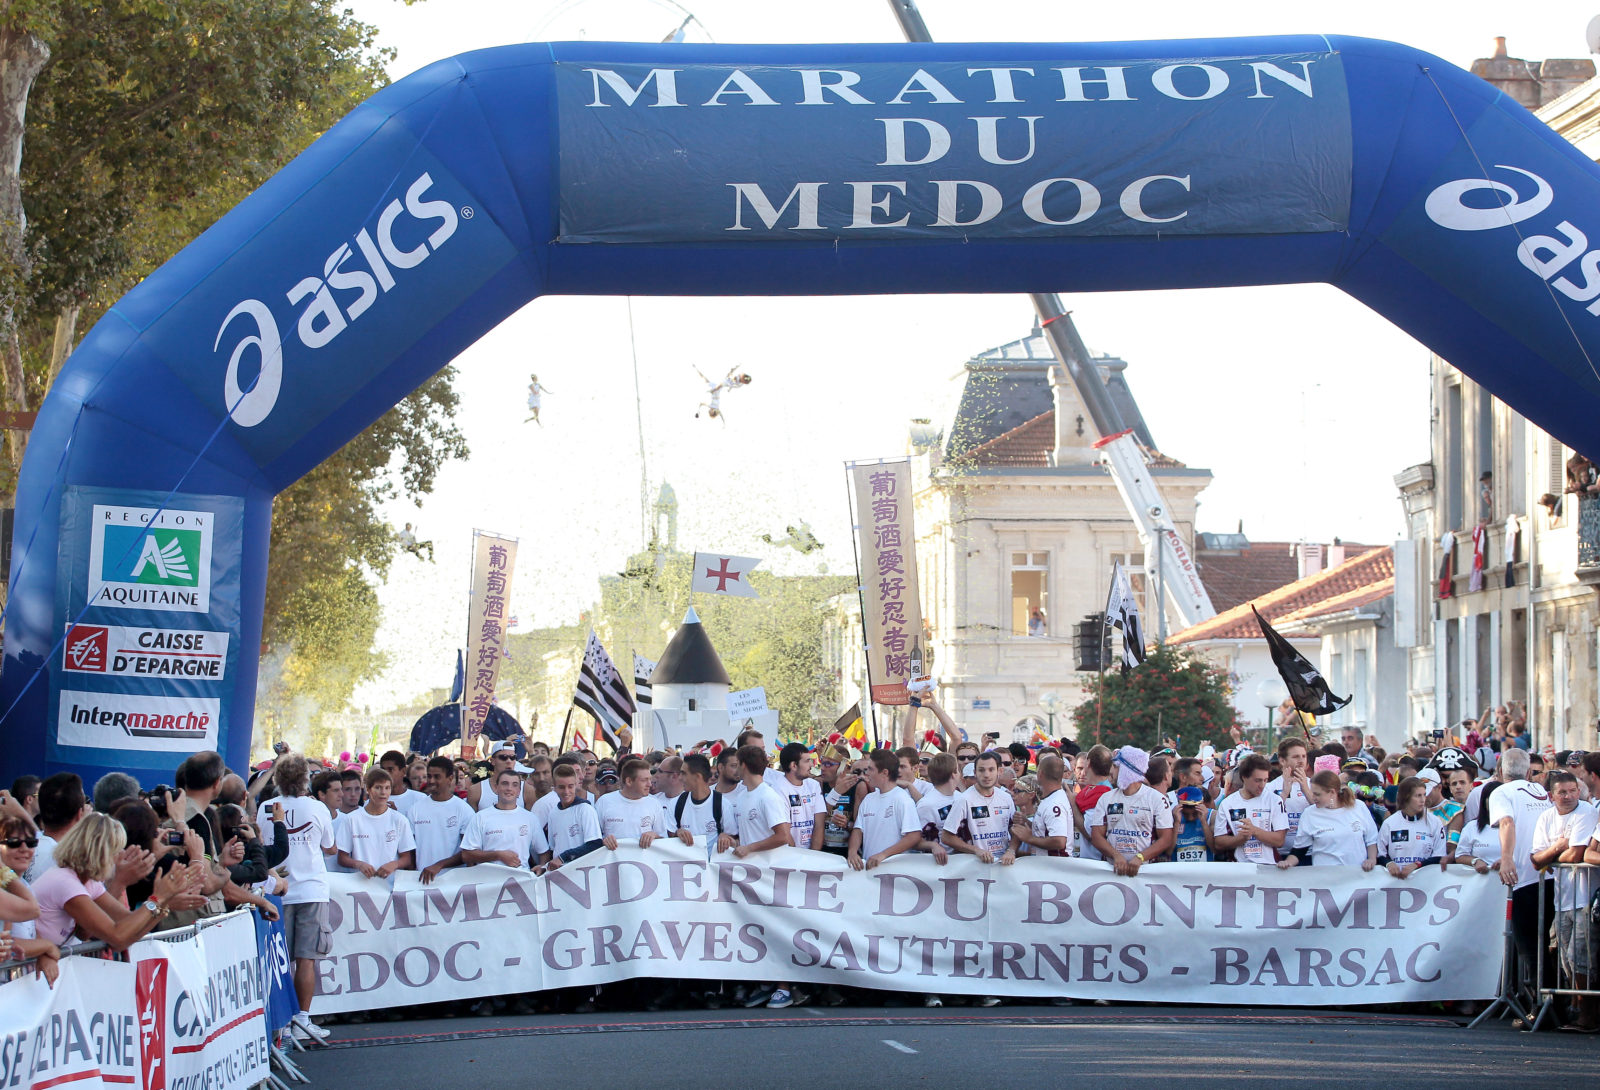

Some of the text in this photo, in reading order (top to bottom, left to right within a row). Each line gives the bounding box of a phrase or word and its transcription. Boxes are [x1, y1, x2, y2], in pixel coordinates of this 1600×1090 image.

[585, 61, 1315, 108] MARATHON
[875, 115, 1044, 167] DU
[724, 174, 1192, 232] MEDOC
[105, 511, 203, 526] REGION
[1168, 529, 1193, 572] MOREAU
[100, 587, 199, 606] AQUITAINE
[138, 631, 204, 651] CAISSE
[113, 656, 221, 677] D'EPARGNE
[71, 704, 209, 736] Intermarché
[1180, 851, 1204, 860] 8537
[871, 872, 996, 923] DU
[1020, 880, 1462, 931] BONTEMPS
[312, 940, 483, 997] EDOC
[542, 917, 768, 972] GRAVES
[790, 927, 1150, 984] SAUTERNES
[1210, 941, 1443, 987] BARSAC
